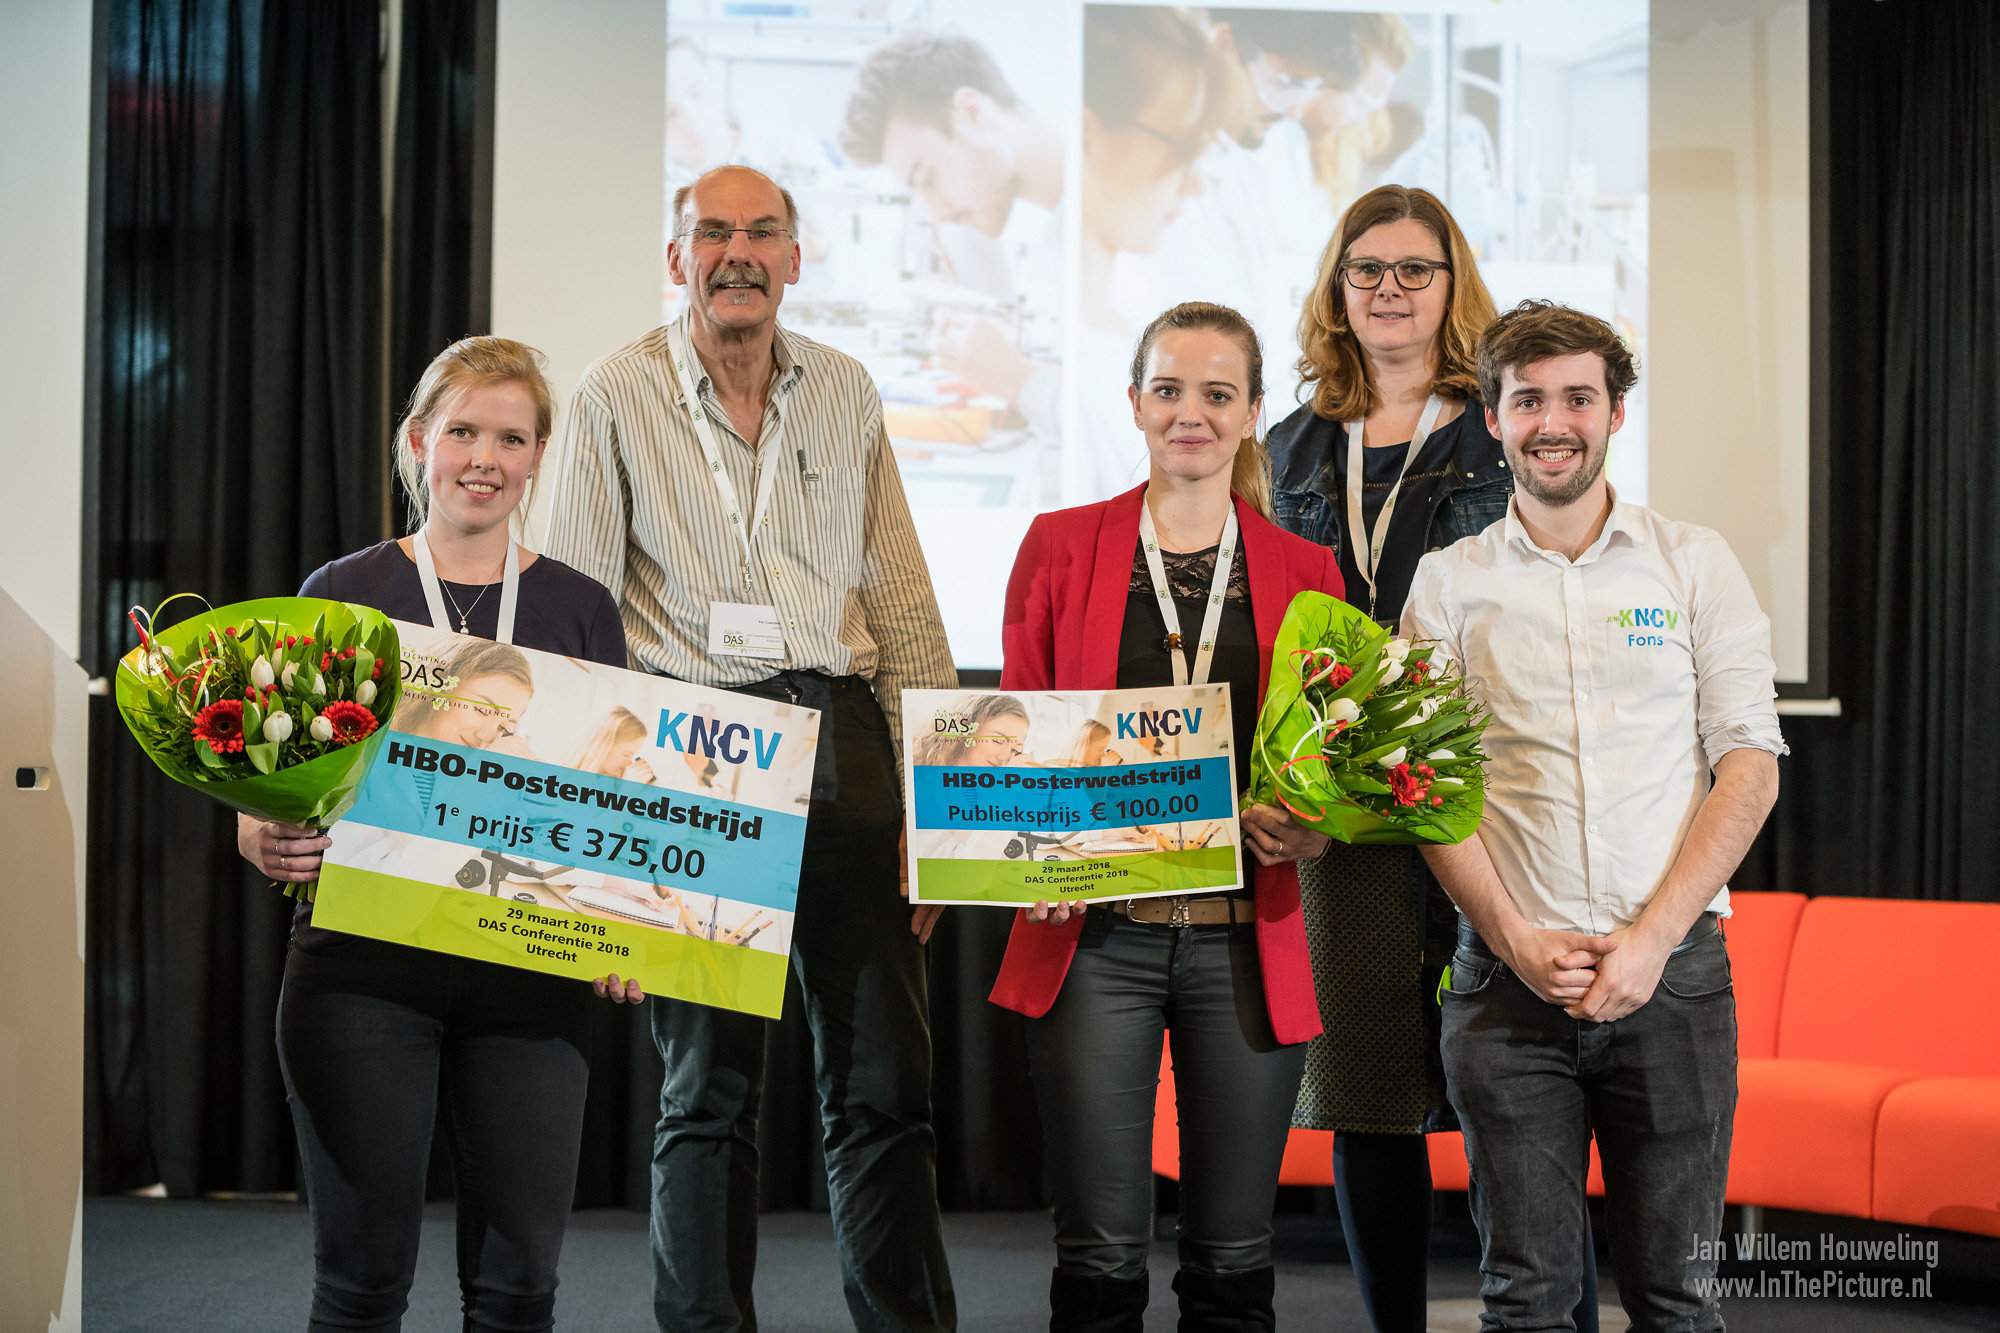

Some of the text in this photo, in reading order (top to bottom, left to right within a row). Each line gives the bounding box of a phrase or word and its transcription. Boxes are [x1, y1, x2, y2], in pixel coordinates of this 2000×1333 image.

[1619, 608, 1678, 630] KNCV
[723, 634, 744, 645] DAS
[1628, 634, 1664, 647] Fons
[403, 651, 447, 666] TICHTING
[400, 659, 445, 688] DAS
[403, 691, 427, 701] MEIN
[934, 718, 970, 733] DAS
[1116, 707, 1203, 740] KNCV
[656, 708, 782, 771] KNCV
[942, 764, 1202, 790] HBO-Posterwedstrijd
[386, 741, 763, 842] HBO-Posterwedstrijd
[948, 794, 1200, 828] Publieksprijs € 100,00
[467, 813, 534, 847] prijs
[547, 822, 574, 852] €
[582, 828, 706, 879] 375,00
[1025, 869, 1129, 884] DAS Conferentie 2018
[1042, 861, 1111, 874] 29 maart 2018
[1059, 883, 1095, 894] Utrecht
[506, 907, 606, 936] 29 maart 2018
[478, 917, 630, 957] DAS Conferentie 2018
[526, 943, 578, 963] Utrecht
